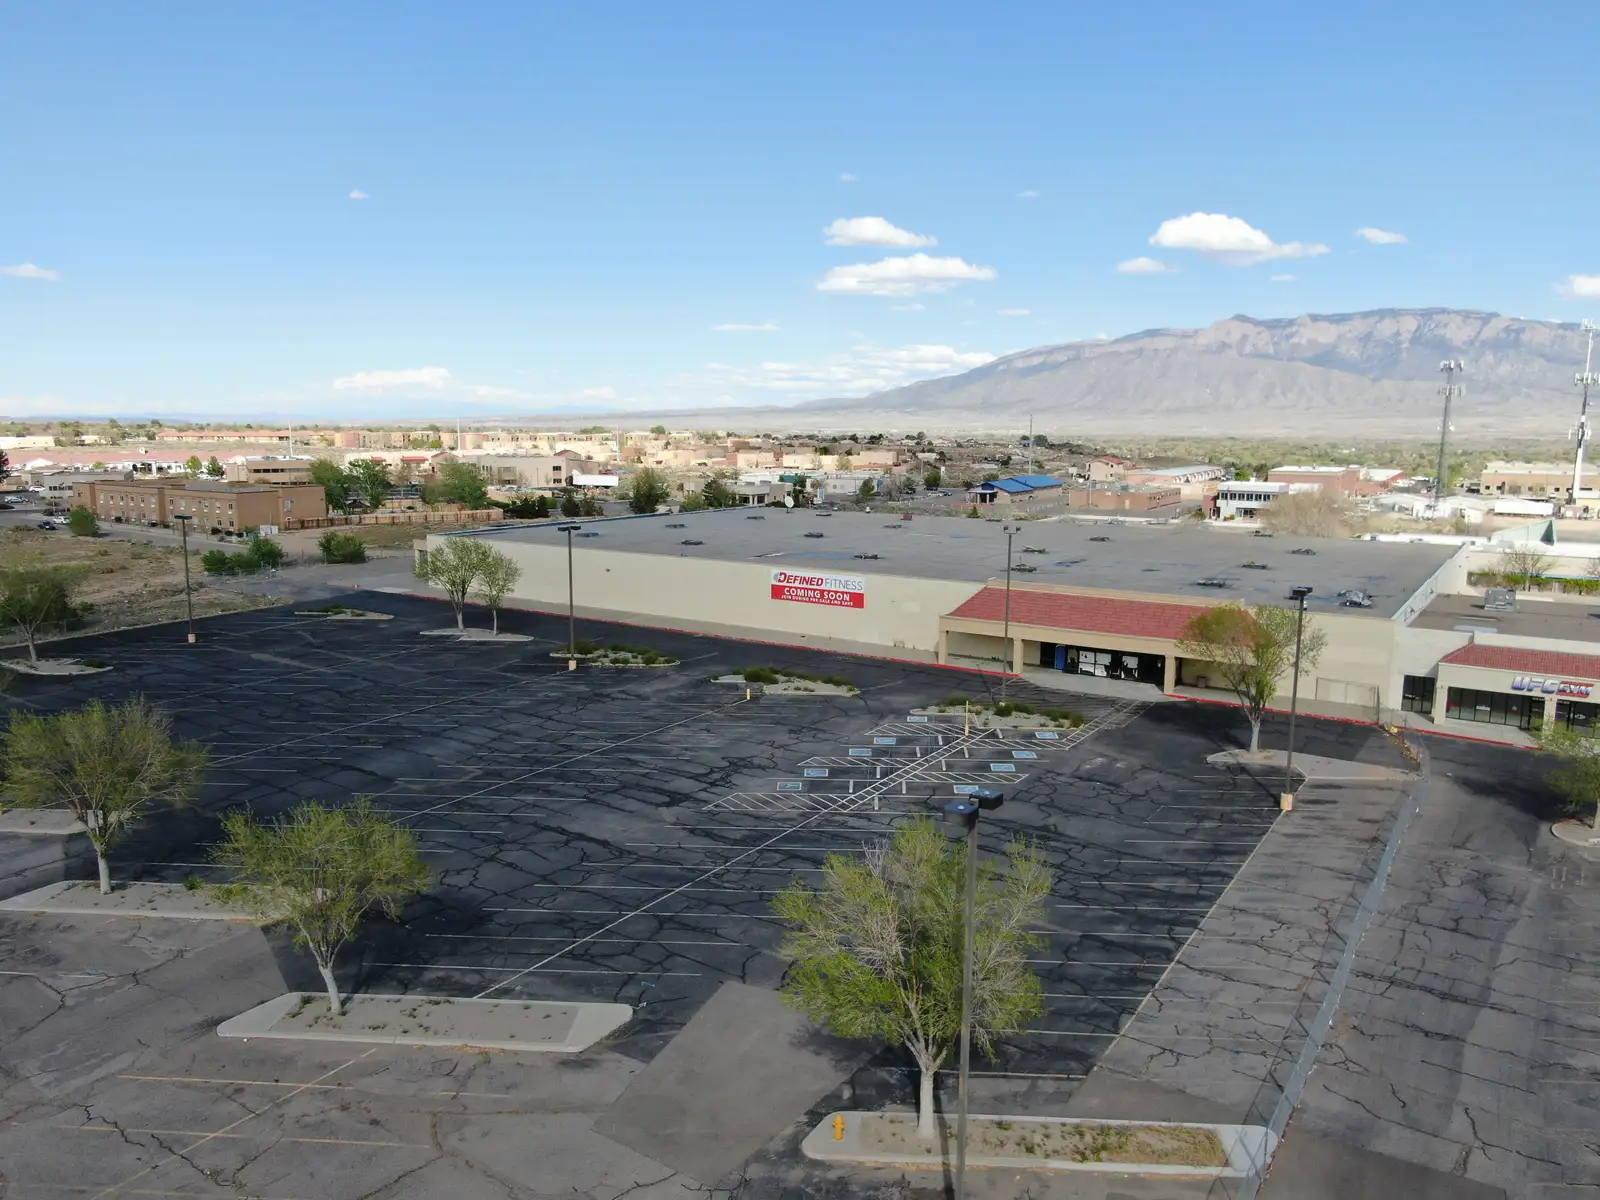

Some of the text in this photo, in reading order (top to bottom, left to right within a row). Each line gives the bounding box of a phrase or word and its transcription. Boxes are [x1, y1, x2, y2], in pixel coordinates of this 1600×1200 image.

[777, 572, 862, 591] DEFINED FITNESS
[784, 587, 850, 602] COMING SOON
[1511, 676, 1593, 695] UFC GYM
